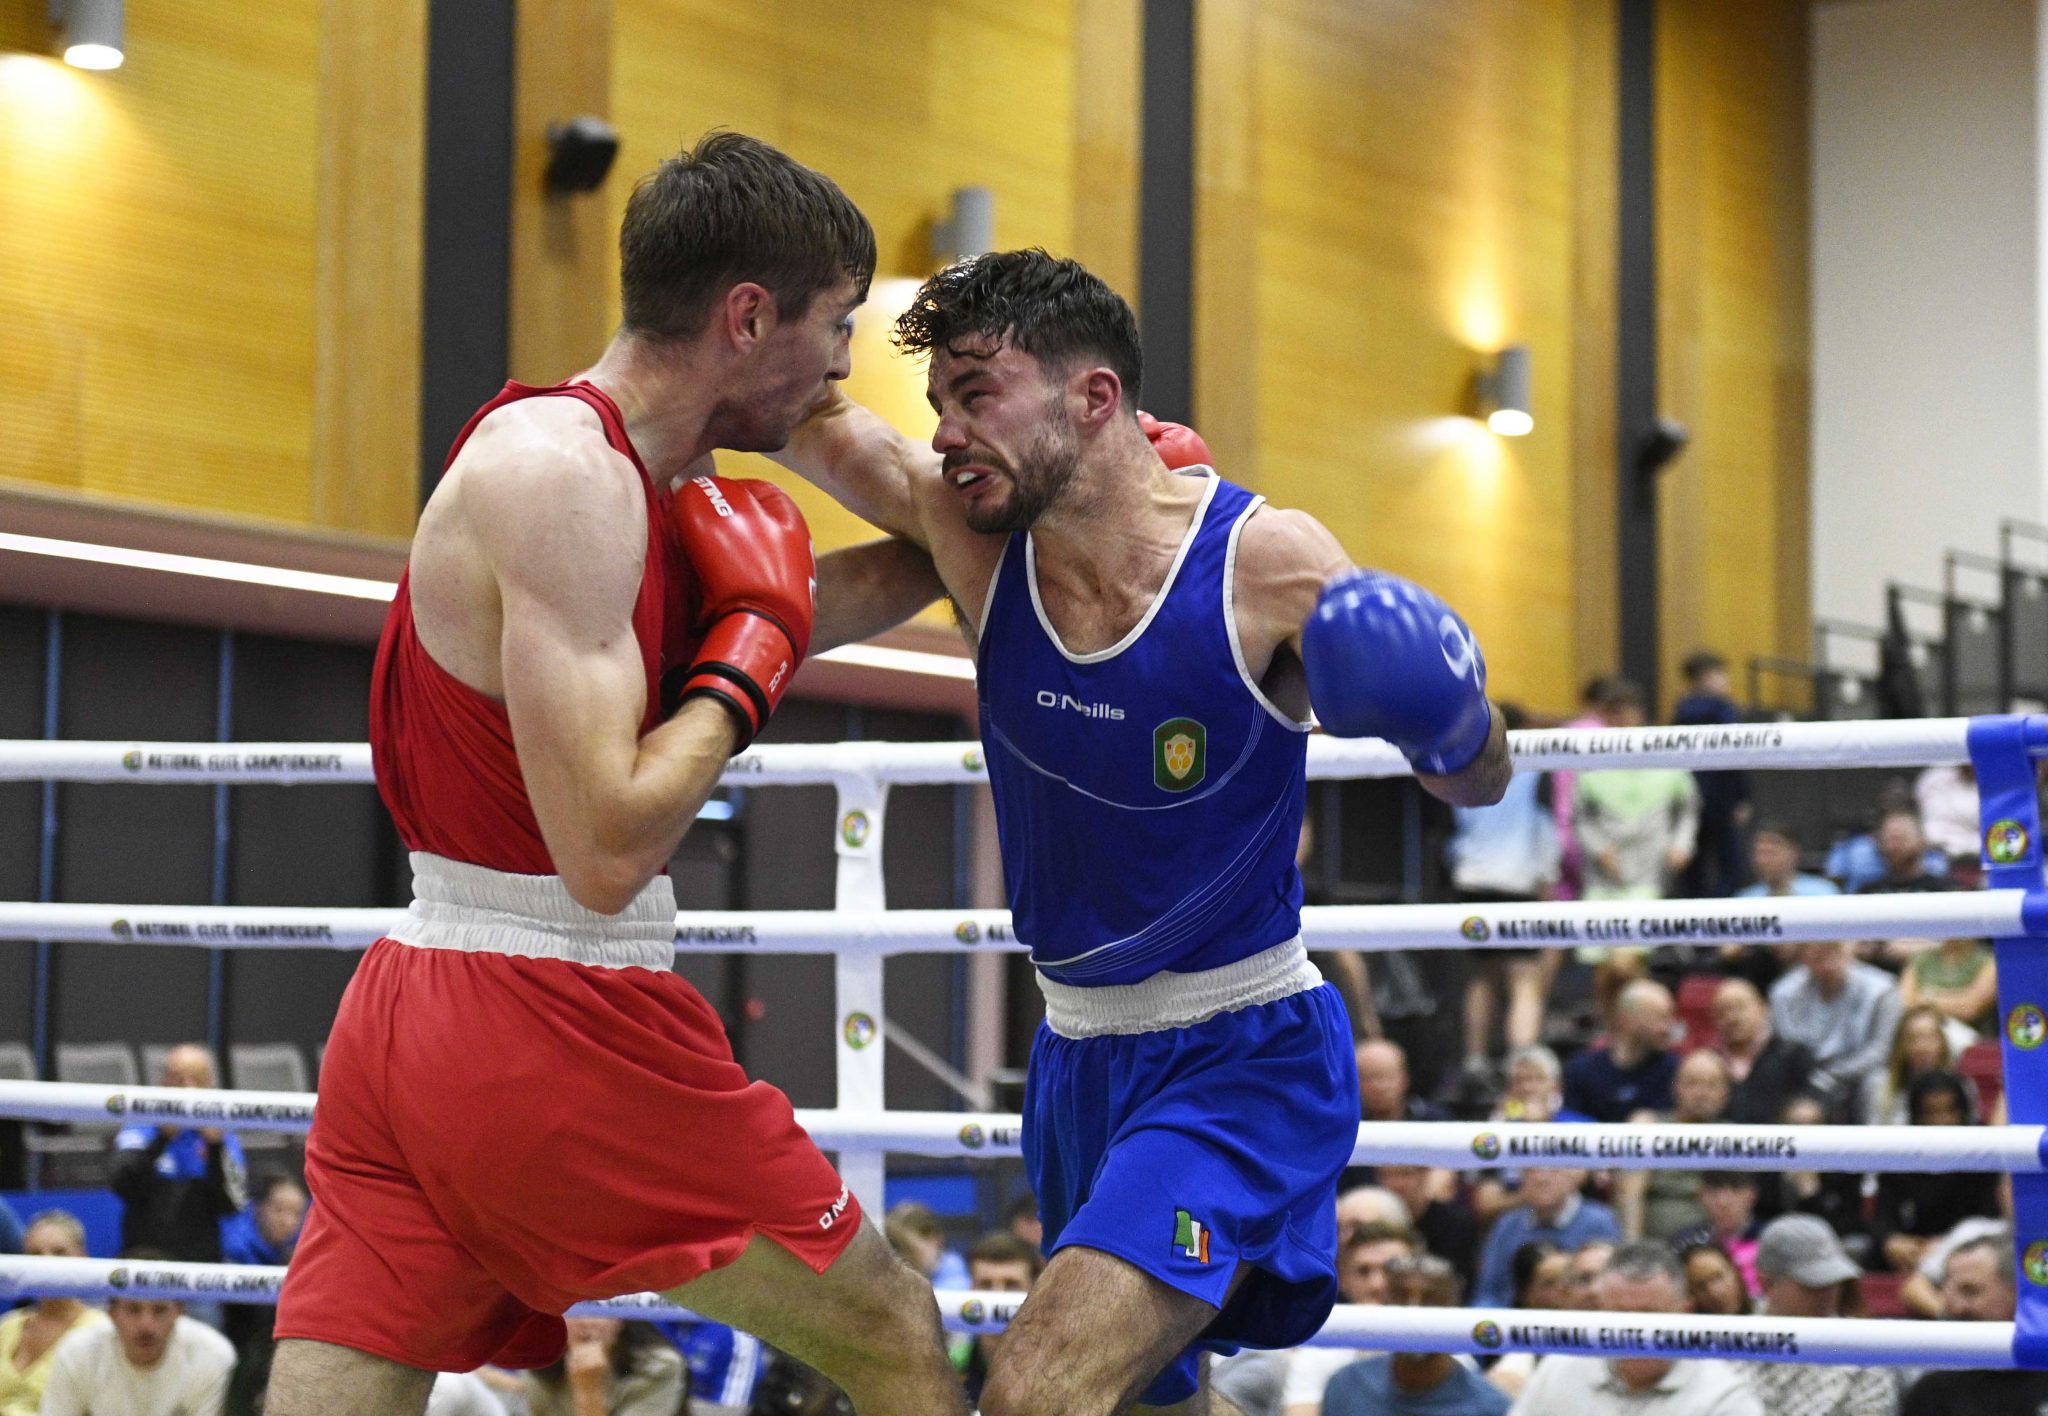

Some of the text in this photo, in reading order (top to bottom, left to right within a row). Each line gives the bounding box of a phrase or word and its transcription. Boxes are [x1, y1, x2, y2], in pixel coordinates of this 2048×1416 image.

[1512, 729, 1783, 756] ATIONAL ELITE CHAMPIONSHIPS
[1497, 915, 1783, 940] NATIONAL ELITE CHAMPIONSHIPS
[1508, 1134, 1797, 1158] NATIONAL ELITE CHAMPIONSHIPS
[1509, 1325, 1799, 1355] NATIONAL ELITE CHAMPIONSHIPS
